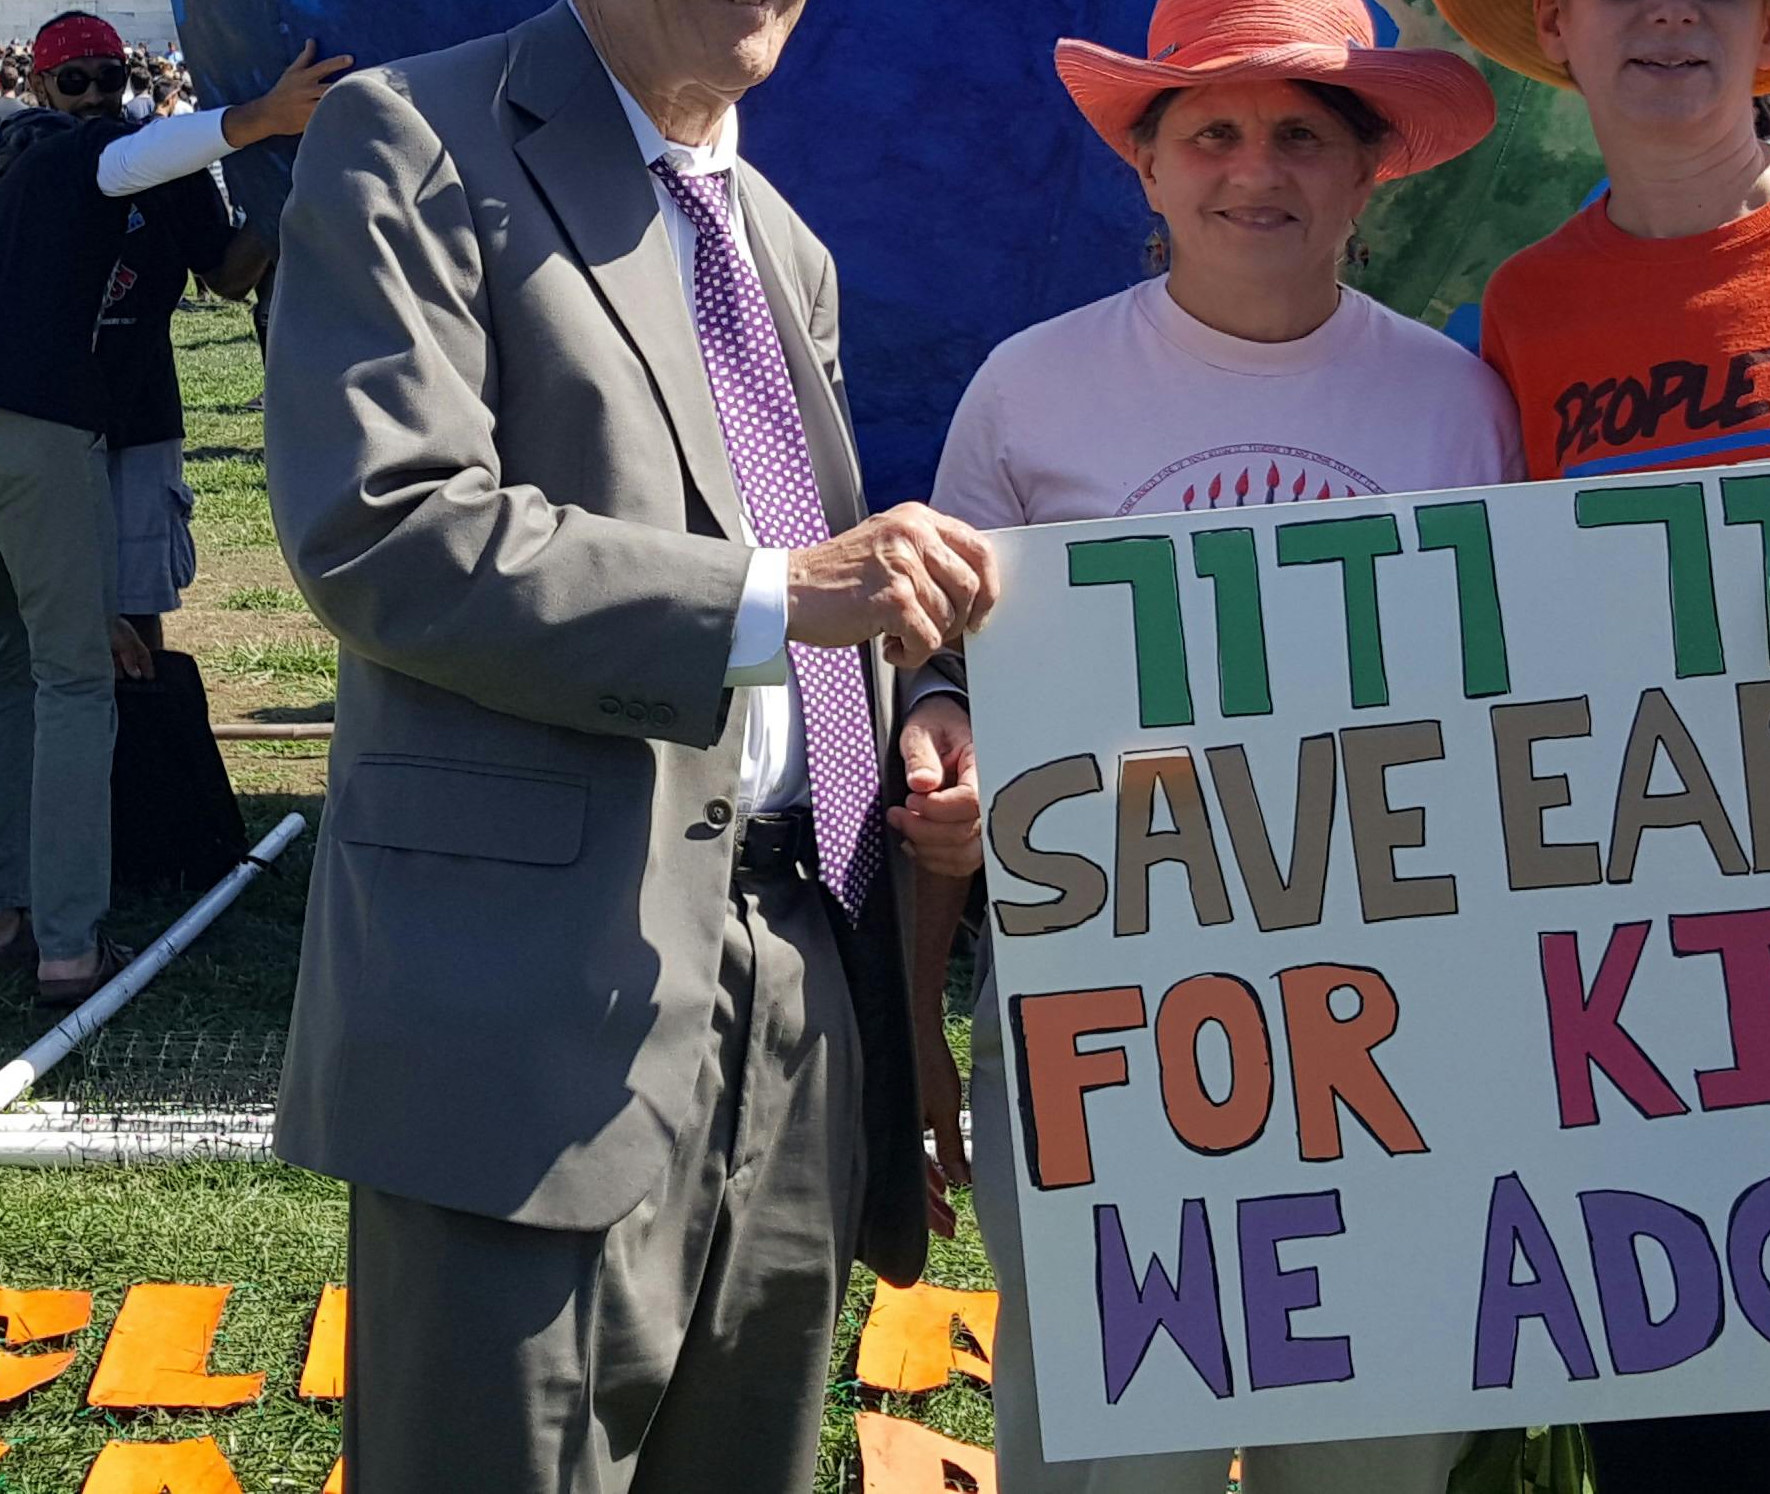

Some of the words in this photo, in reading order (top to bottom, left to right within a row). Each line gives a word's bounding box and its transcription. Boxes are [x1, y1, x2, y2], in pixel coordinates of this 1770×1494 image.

[1068, 501, 1510, 727] ודור
[988, 719, 1459, 938] SAVE
[1012, 962, 1430, 1190] FOR
[1092, 1188, 1355, 1405] WE
